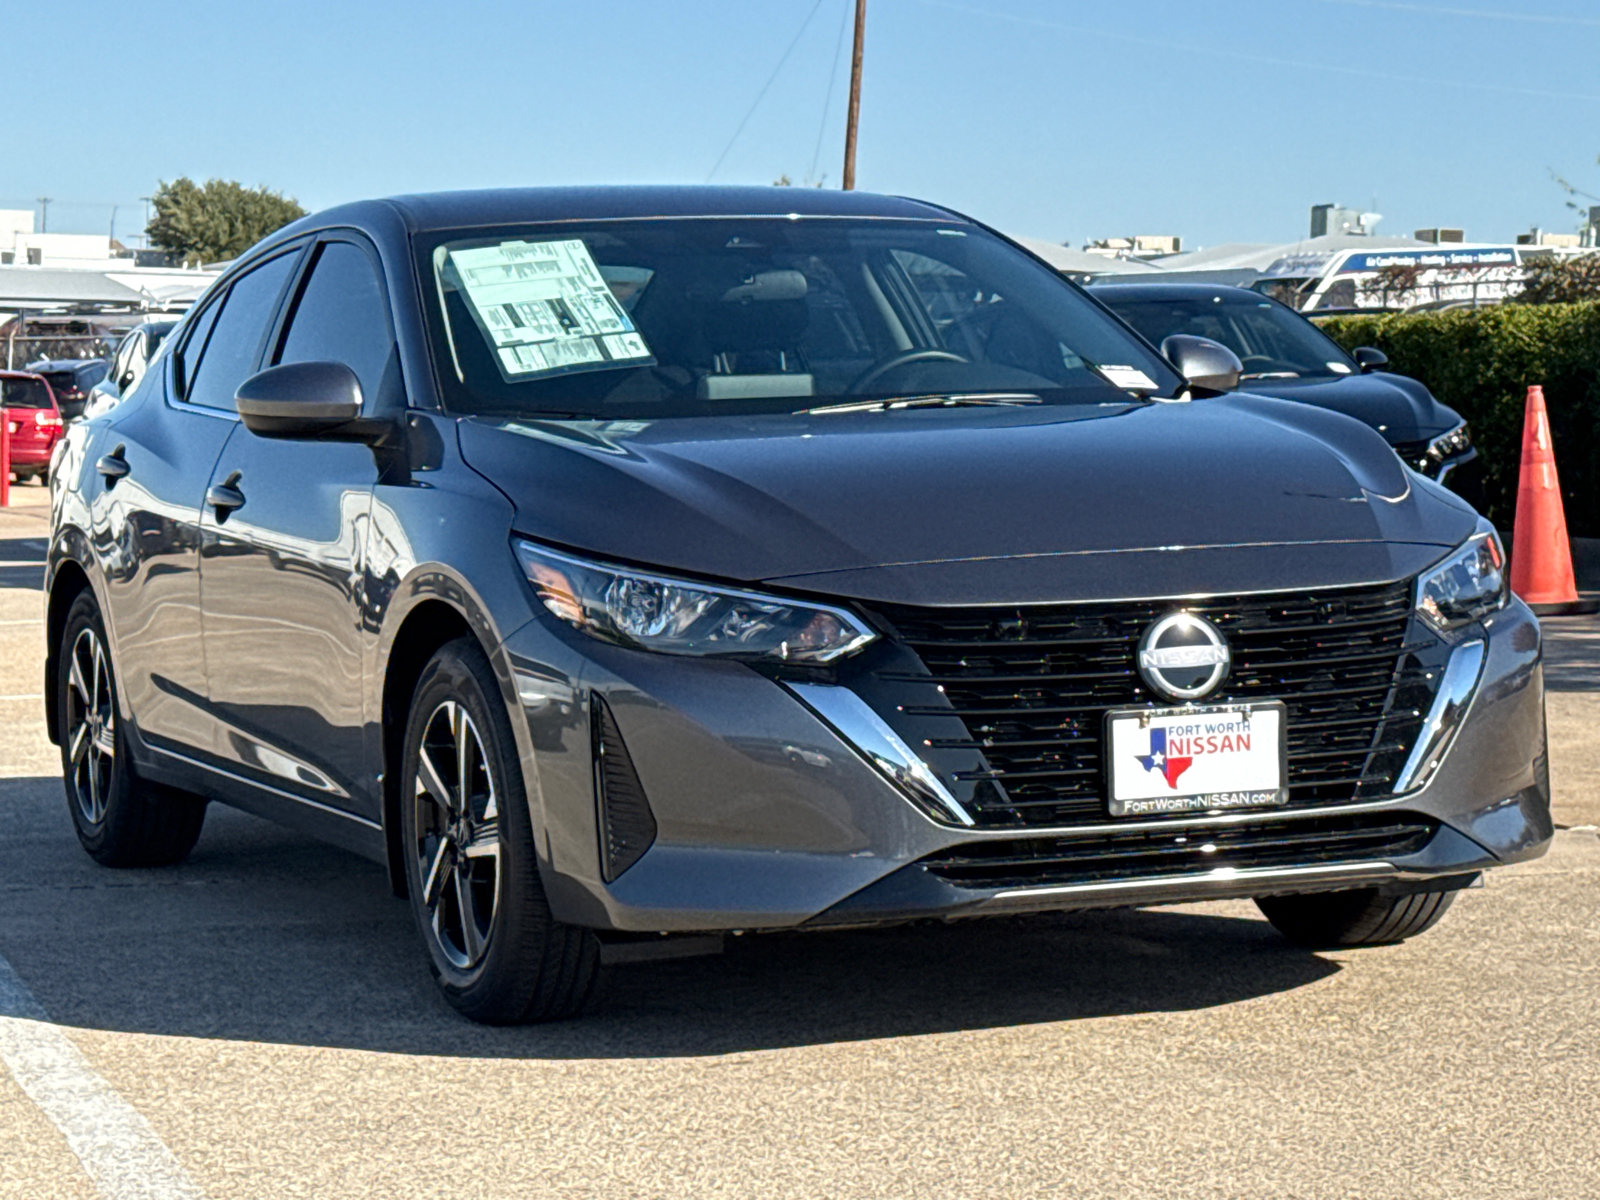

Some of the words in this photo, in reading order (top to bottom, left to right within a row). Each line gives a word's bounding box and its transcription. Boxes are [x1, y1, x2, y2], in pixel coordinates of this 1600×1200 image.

[1142, 647, 1227, 666] NISSAN
[1168, 724, 1202, 737] FORT
[1205, 721, 1251, 735] WORTH
[1169, 733, 1251, 757] NISSAN
